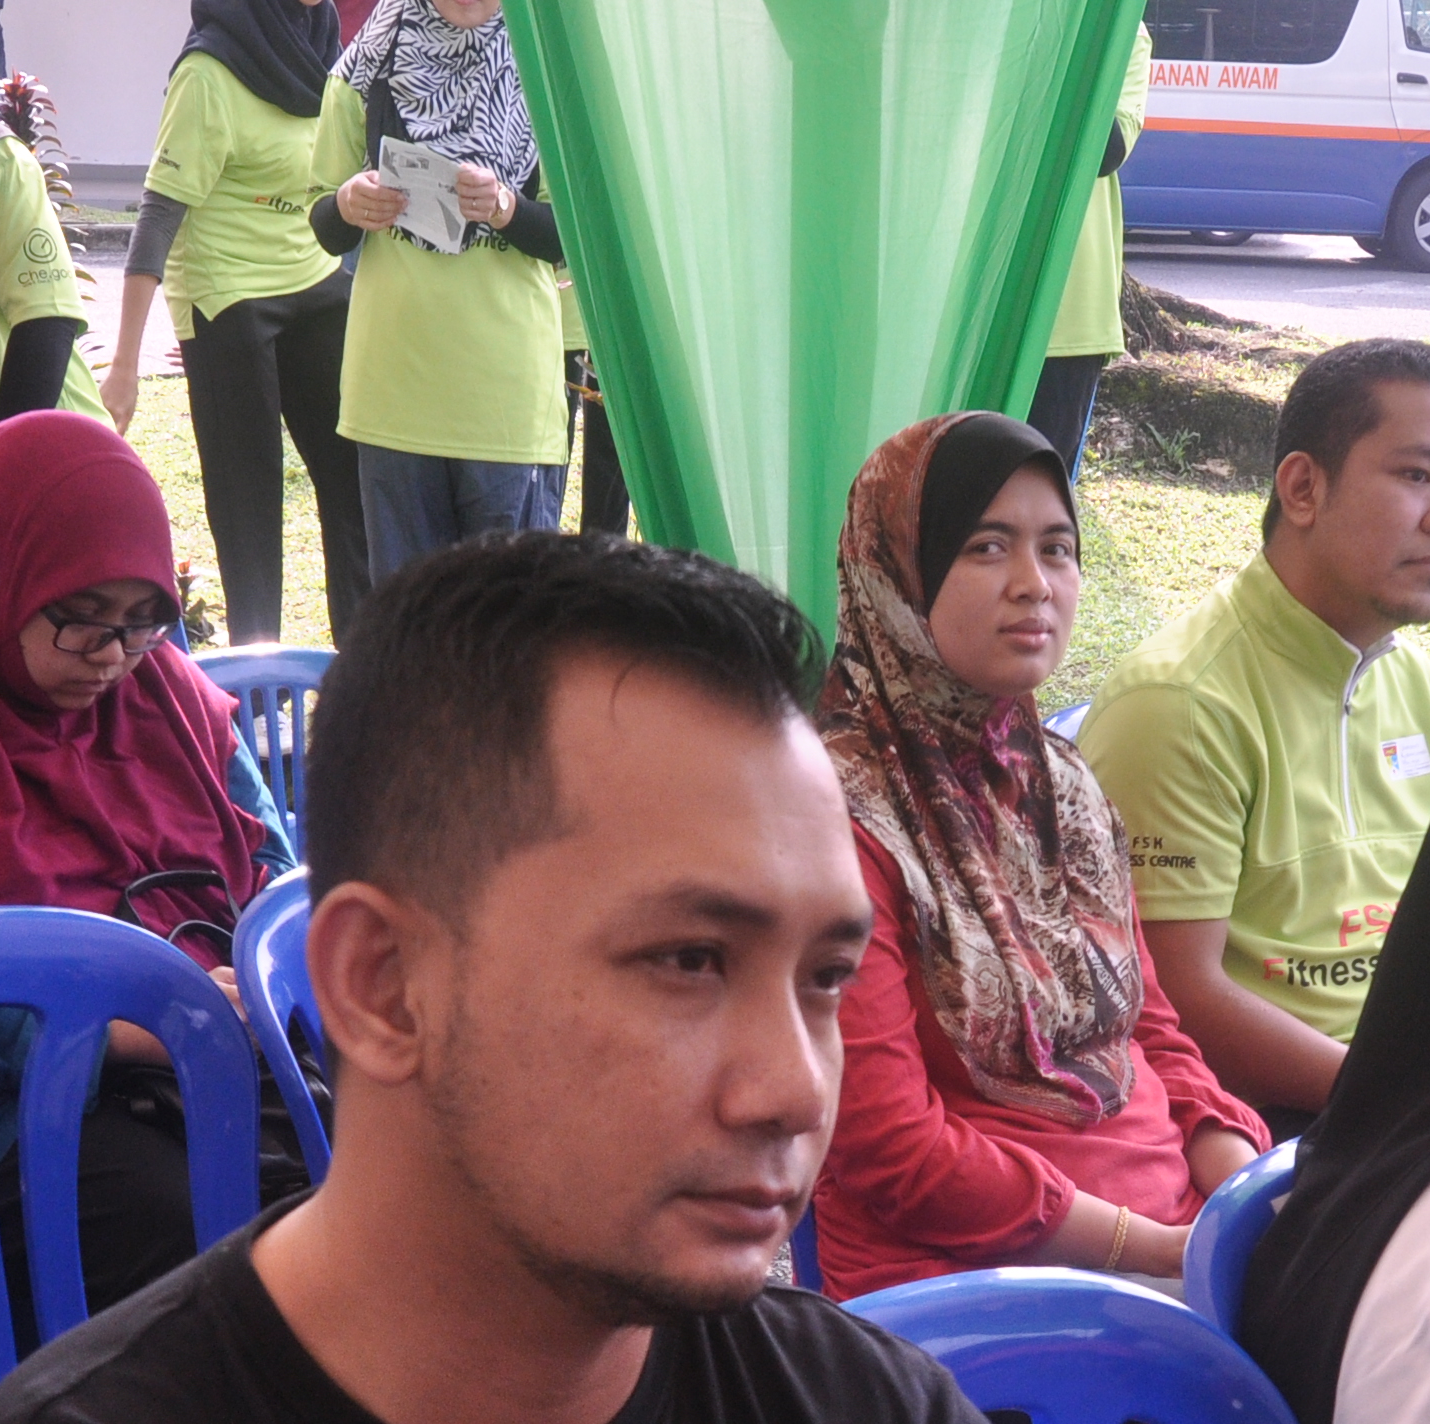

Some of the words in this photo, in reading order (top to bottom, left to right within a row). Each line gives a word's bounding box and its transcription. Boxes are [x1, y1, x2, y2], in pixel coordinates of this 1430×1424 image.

[1218, 65, 1278, 90] AWAM
[1149, 855, 1196, 869] CENTRE
[1338, 902, 1400, 948] FS
